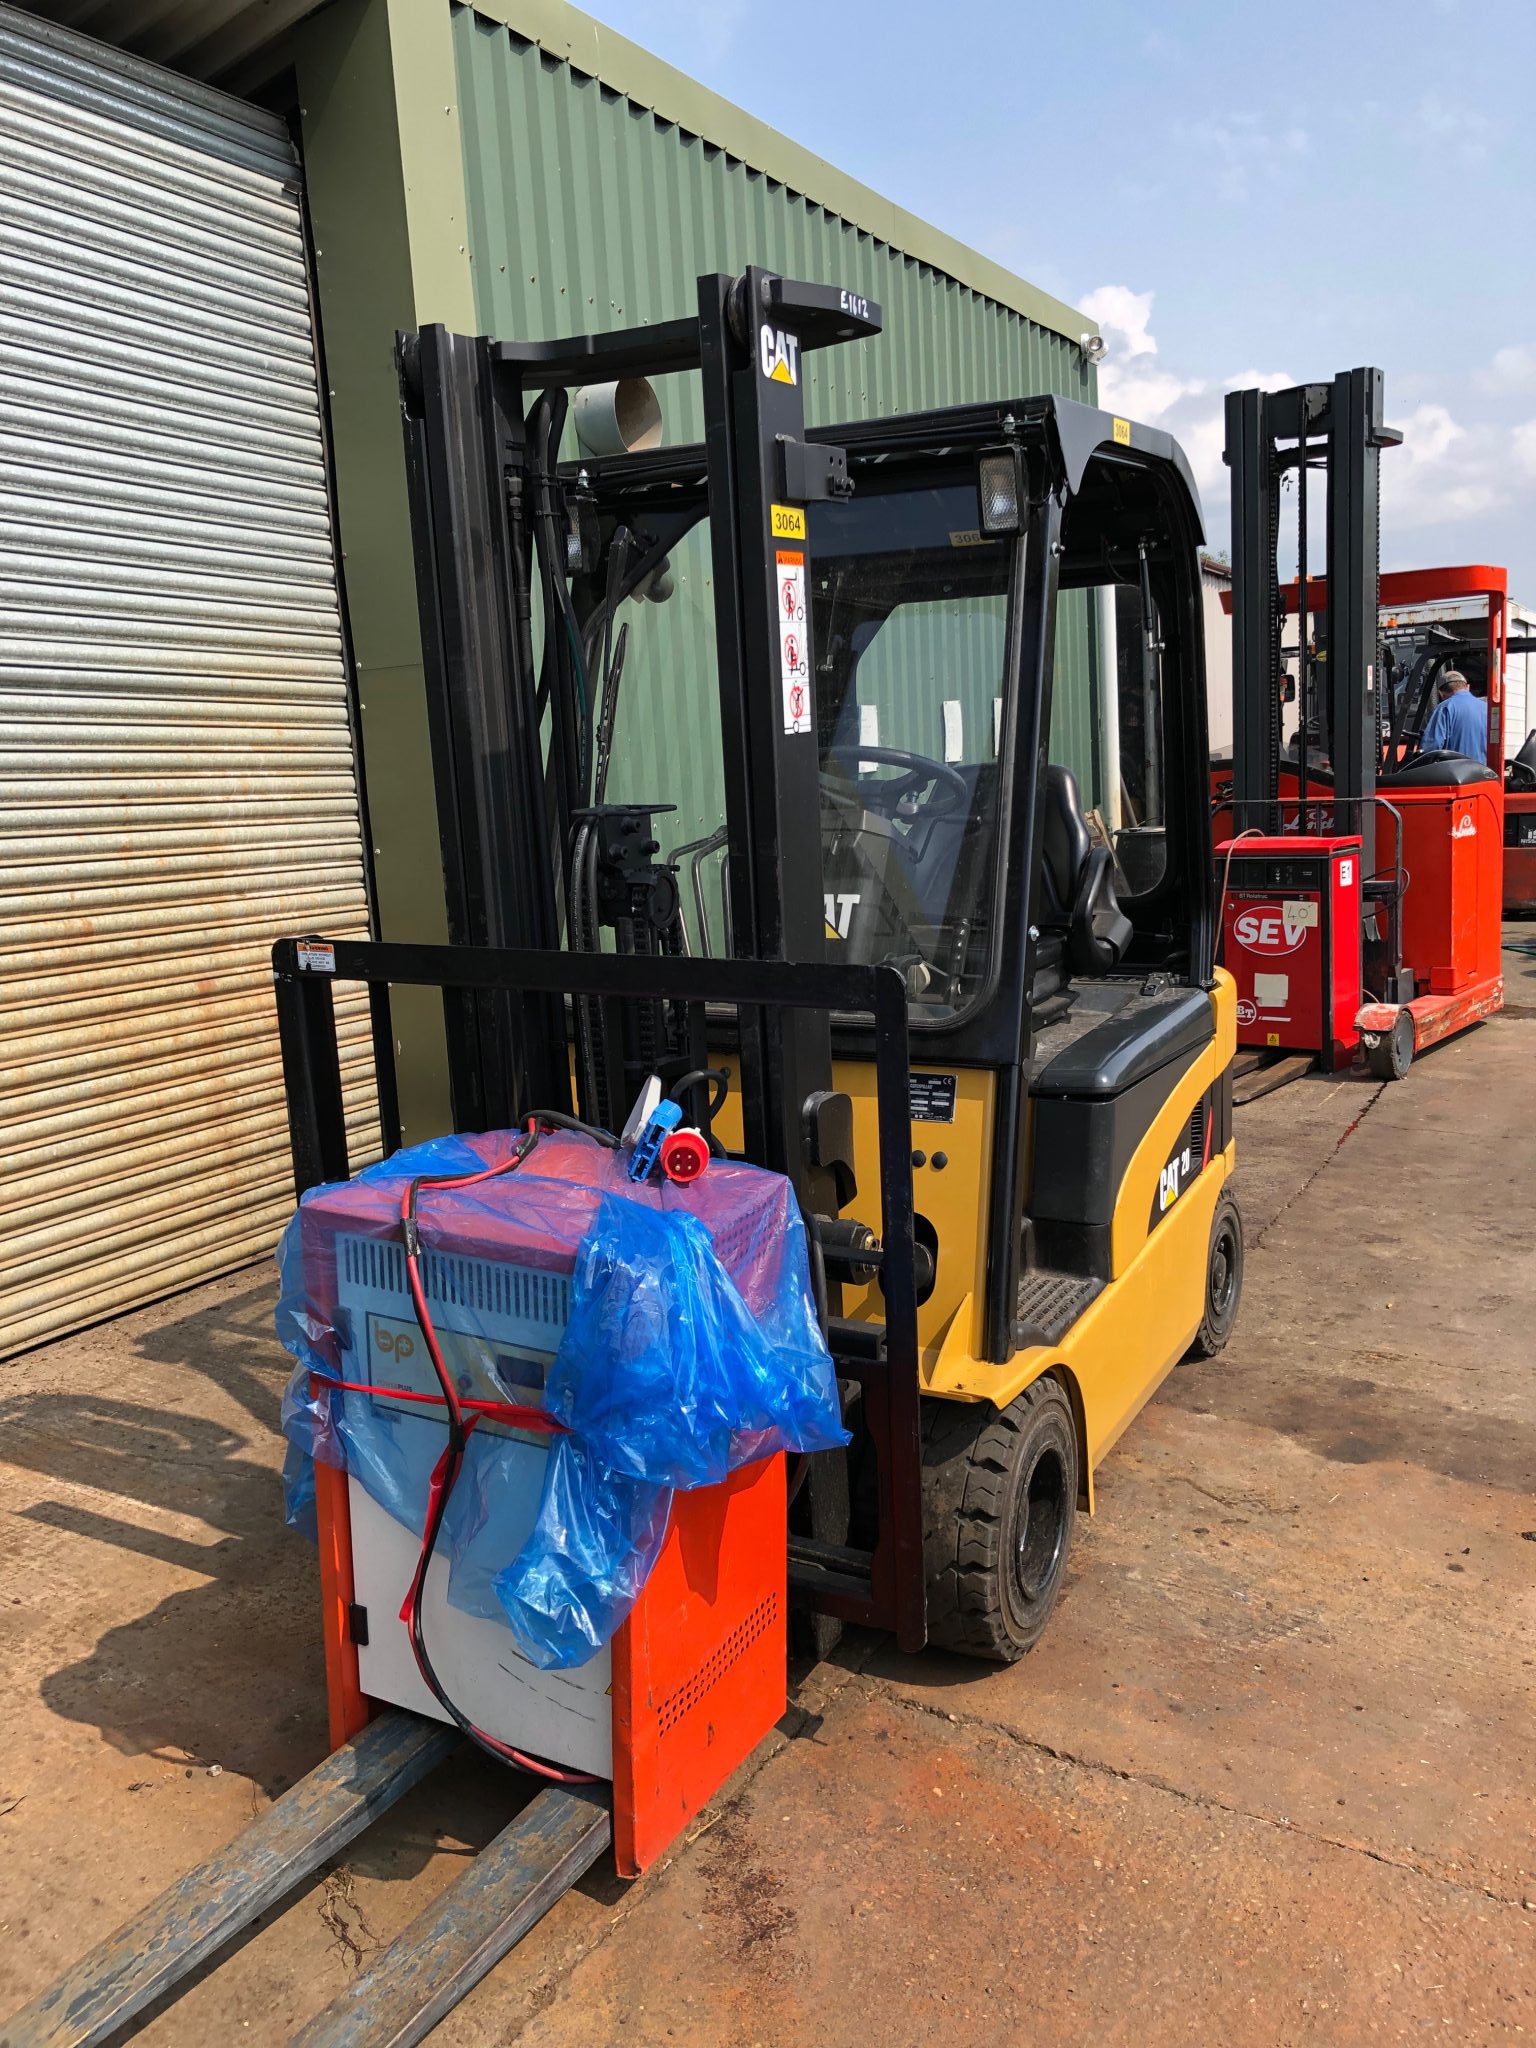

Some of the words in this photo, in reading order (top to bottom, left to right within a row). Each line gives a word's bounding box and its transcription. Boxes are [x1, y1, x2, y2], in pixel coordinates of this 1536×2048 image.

[761, 324, 798, 386] CAT
[775, 512, 801, 531] 3064
[954, 533, 981, 544] 306
[1236, 917, 1304, 946] SEV
[1160, 1157, 1179, 1211] CAT
[1181, 1147, 1190, 1176] 20
[374, 1319, 415, 1364] bp
